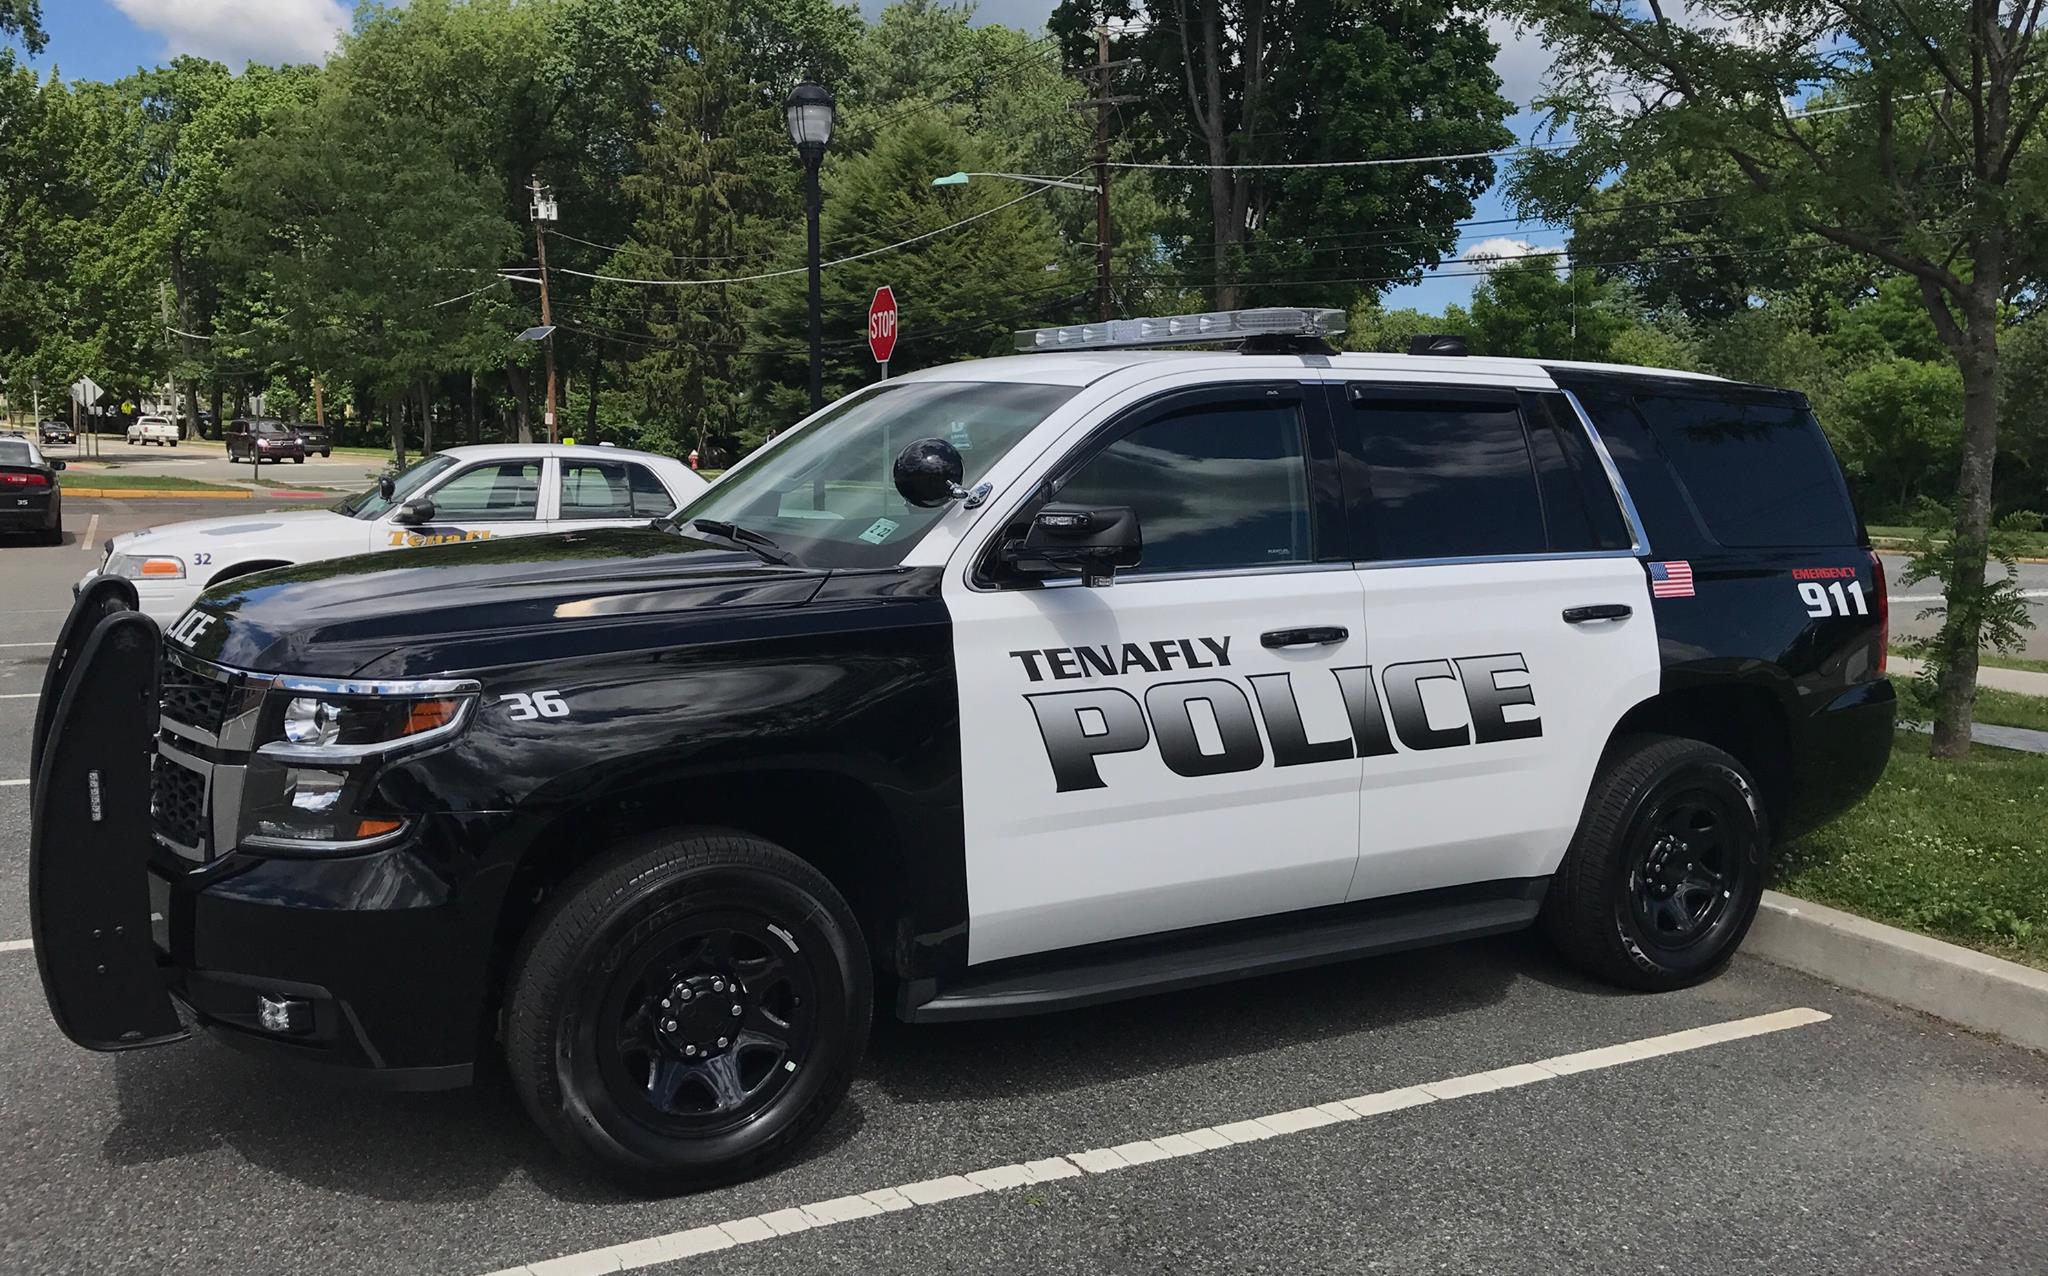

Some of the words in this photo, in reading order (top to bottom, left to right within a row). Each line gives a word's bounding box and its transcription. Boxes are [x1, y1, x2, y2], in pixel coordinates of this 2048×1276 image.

[871, 309, 895, 339] STOP
[388, 530, 491, 546] Tenafl
[193, 552, 212, 566] 32
[1792, 567, 1856, 580] EMERGENCY
[1797, 580, 1869, 618] 911
[1009, 635, 1232, 682] TENAFLY
[499, 689, 570, 721] 36
[1022, 652, 1543, 793] POLICE
